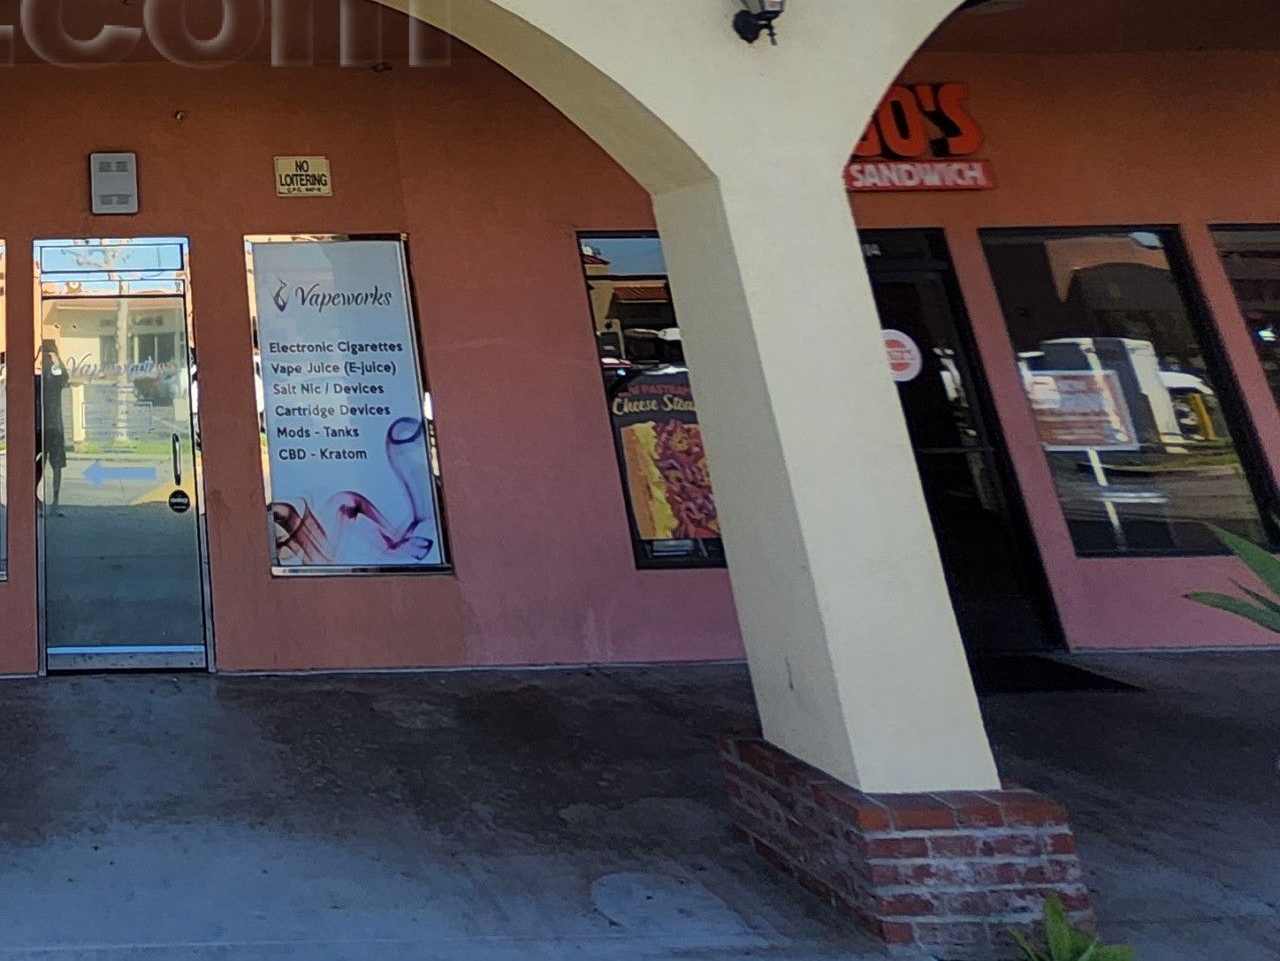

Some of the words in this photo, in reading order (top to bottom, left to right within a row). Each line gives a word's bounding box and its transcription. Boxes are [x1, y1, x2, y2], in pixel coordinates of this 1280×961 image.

[294, 160, 310, 173] NO
[849, 160, 988, 188] SANDWICH
[279, 173, 328, 187] LOITERING
[295, 283, 393, 312] Vapeworks
[269, 341, 334, 354] Electronic
[337, 340, 404, 356] Cigarettes
[271, 363, 302, 376] Vape
[307, 362, 340, 374] Juice
[344, 361, 397, 377] (E-juice)
[273, 383, 297, 395] Salt
[301, 382, 321, 394] Nic
[333, 382, 385, 394] Devices
[275, 404, 335, 419] Cartridge
[340, 404, 391, 416] Devices
[612, 397, 660, 416] Cheese
[661, 393, 695, 412] Stea
[277, 426, 311, 438] Mods
[323, 426, 360, 438] Tanks
[279, 448, 307, 461] CBD
[320, 448, 368, 461] Kratom
